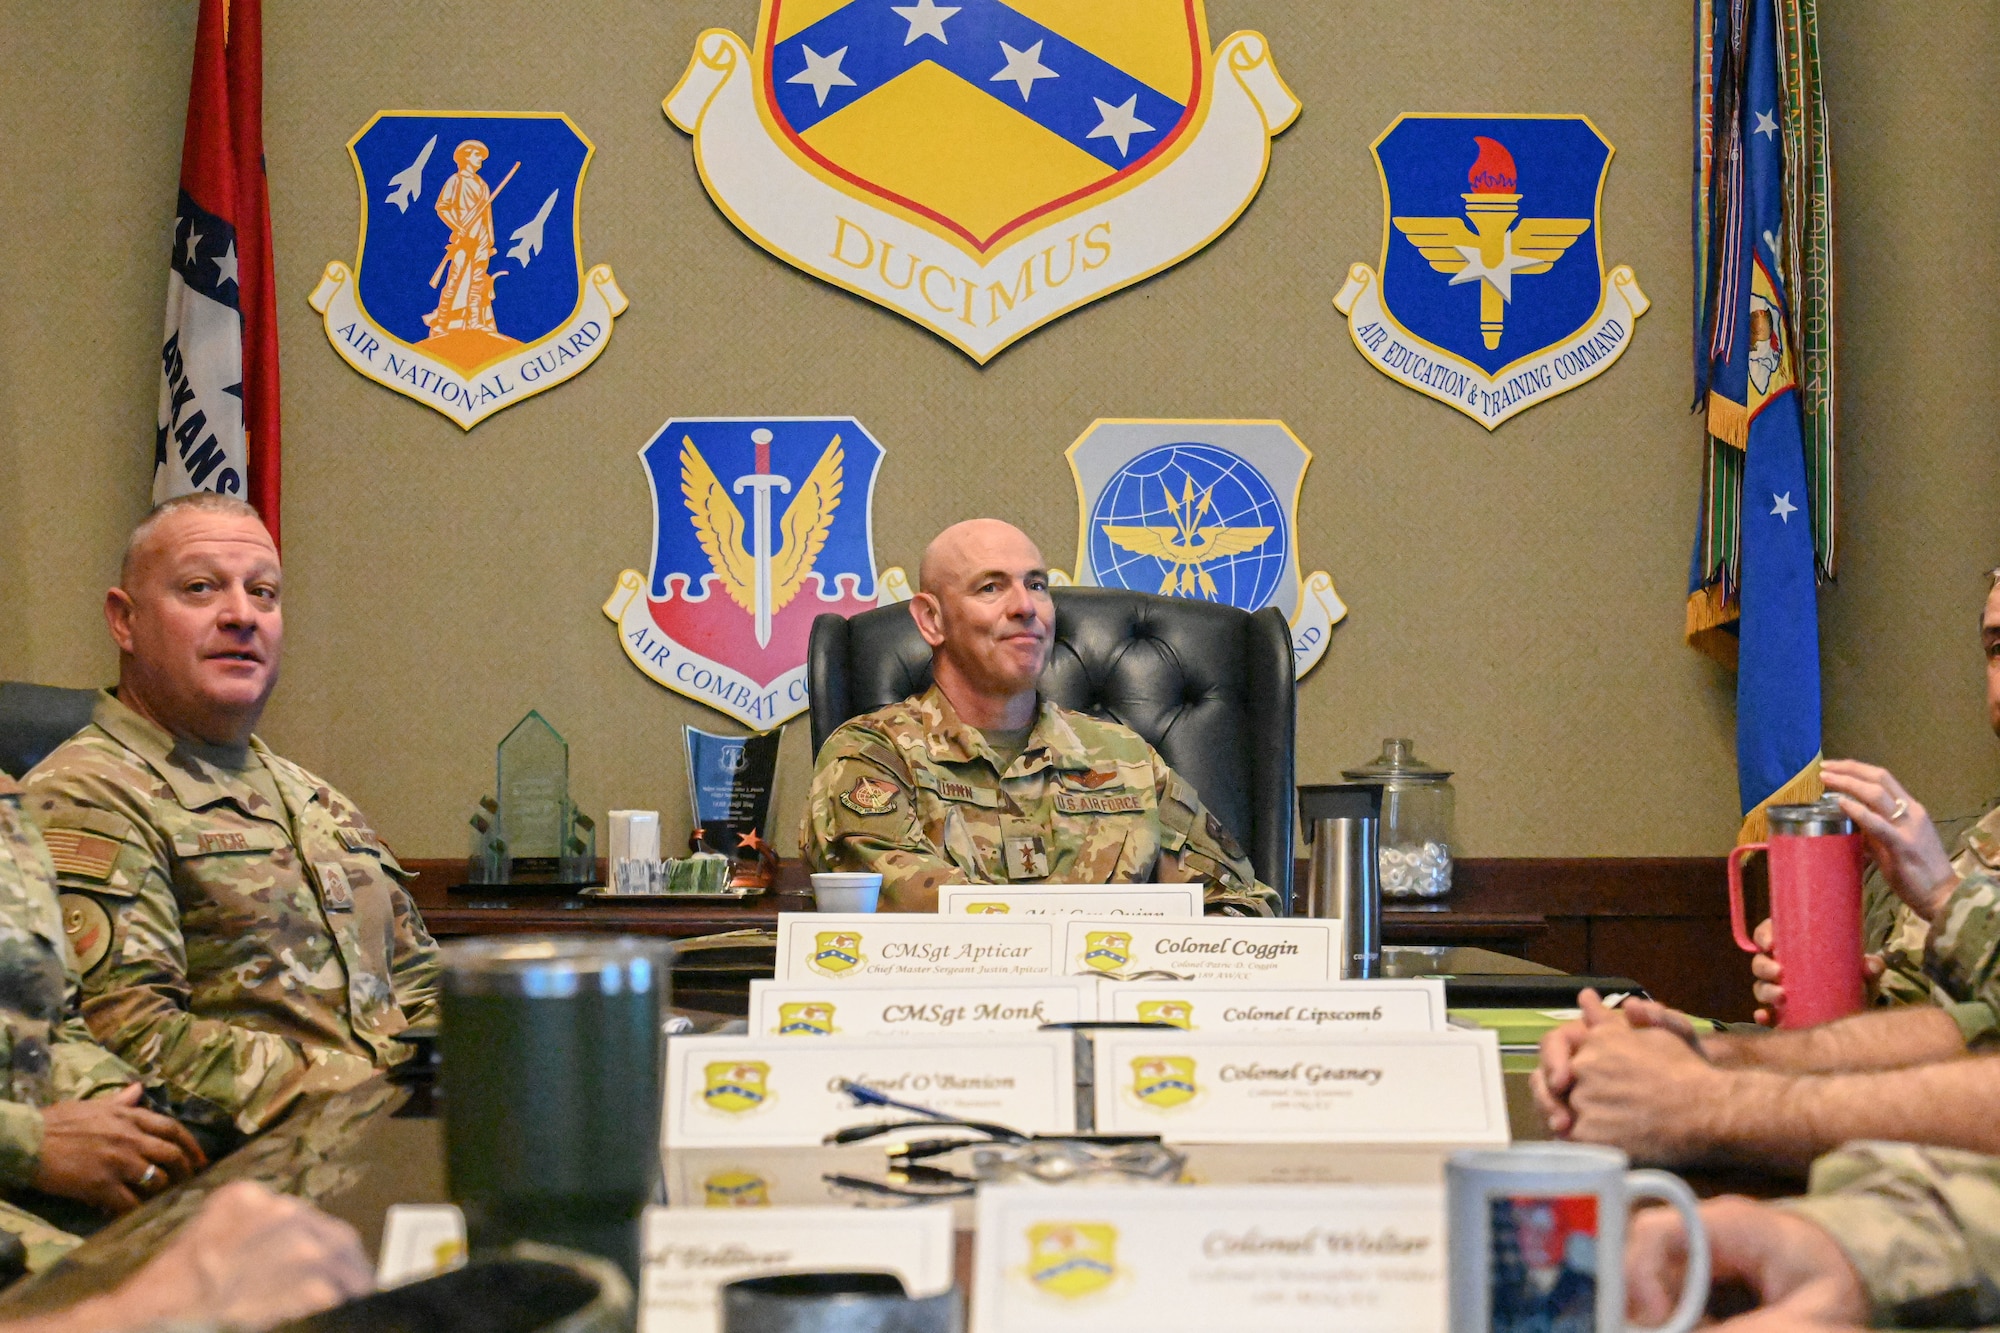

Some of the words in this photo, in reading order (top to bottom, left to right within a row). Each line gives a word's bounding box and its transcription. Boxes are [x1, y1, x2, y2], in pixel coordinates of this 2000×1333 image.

[828, 214, 1112, 328] DUCIMUS
[336, 321, 380, 362] AIR
[383, 352, 514, 412] NATIONAL
[520, 320, 602, 382] GUARD
[1357, 321, 1389, 352] AIR
[1381, 340, 1471, 400] EDUCATION
[1467, 383, 1479, 406] &
[1480, 364, 1553, 418] TRAINING
[1553, 318, 1625, 381] COMMAND
[628, 627, 670, 669] AIR
[676, 661, 778, 721] COMBAT
[1080, 797, 1100, 810] AIR
[1101, 796, 1141, 811] FORCE
[881, 942, 951, 963] CMSgt
[954, 942, 1032, 963] Apticar
[1154, 936, 1232, 955] Colonel
[1232, 939, 1299, 960] Coggin
[866, 964, 893, 976] Chief
[896, 965, 931, 974] Master
[933, 965, 975, 976] Sergeant
[977, 964, 1008, 975] Justin
[881, 1003, 967, 1027] CMSgt
[973, 1000, 1051, 1024] Monk
[1222, 1005, 1294, 1023] Colonel
[1295, 1005, 1383, 1025] Lipscomb
[1219, 1060, 1304, 1083] Colonel
